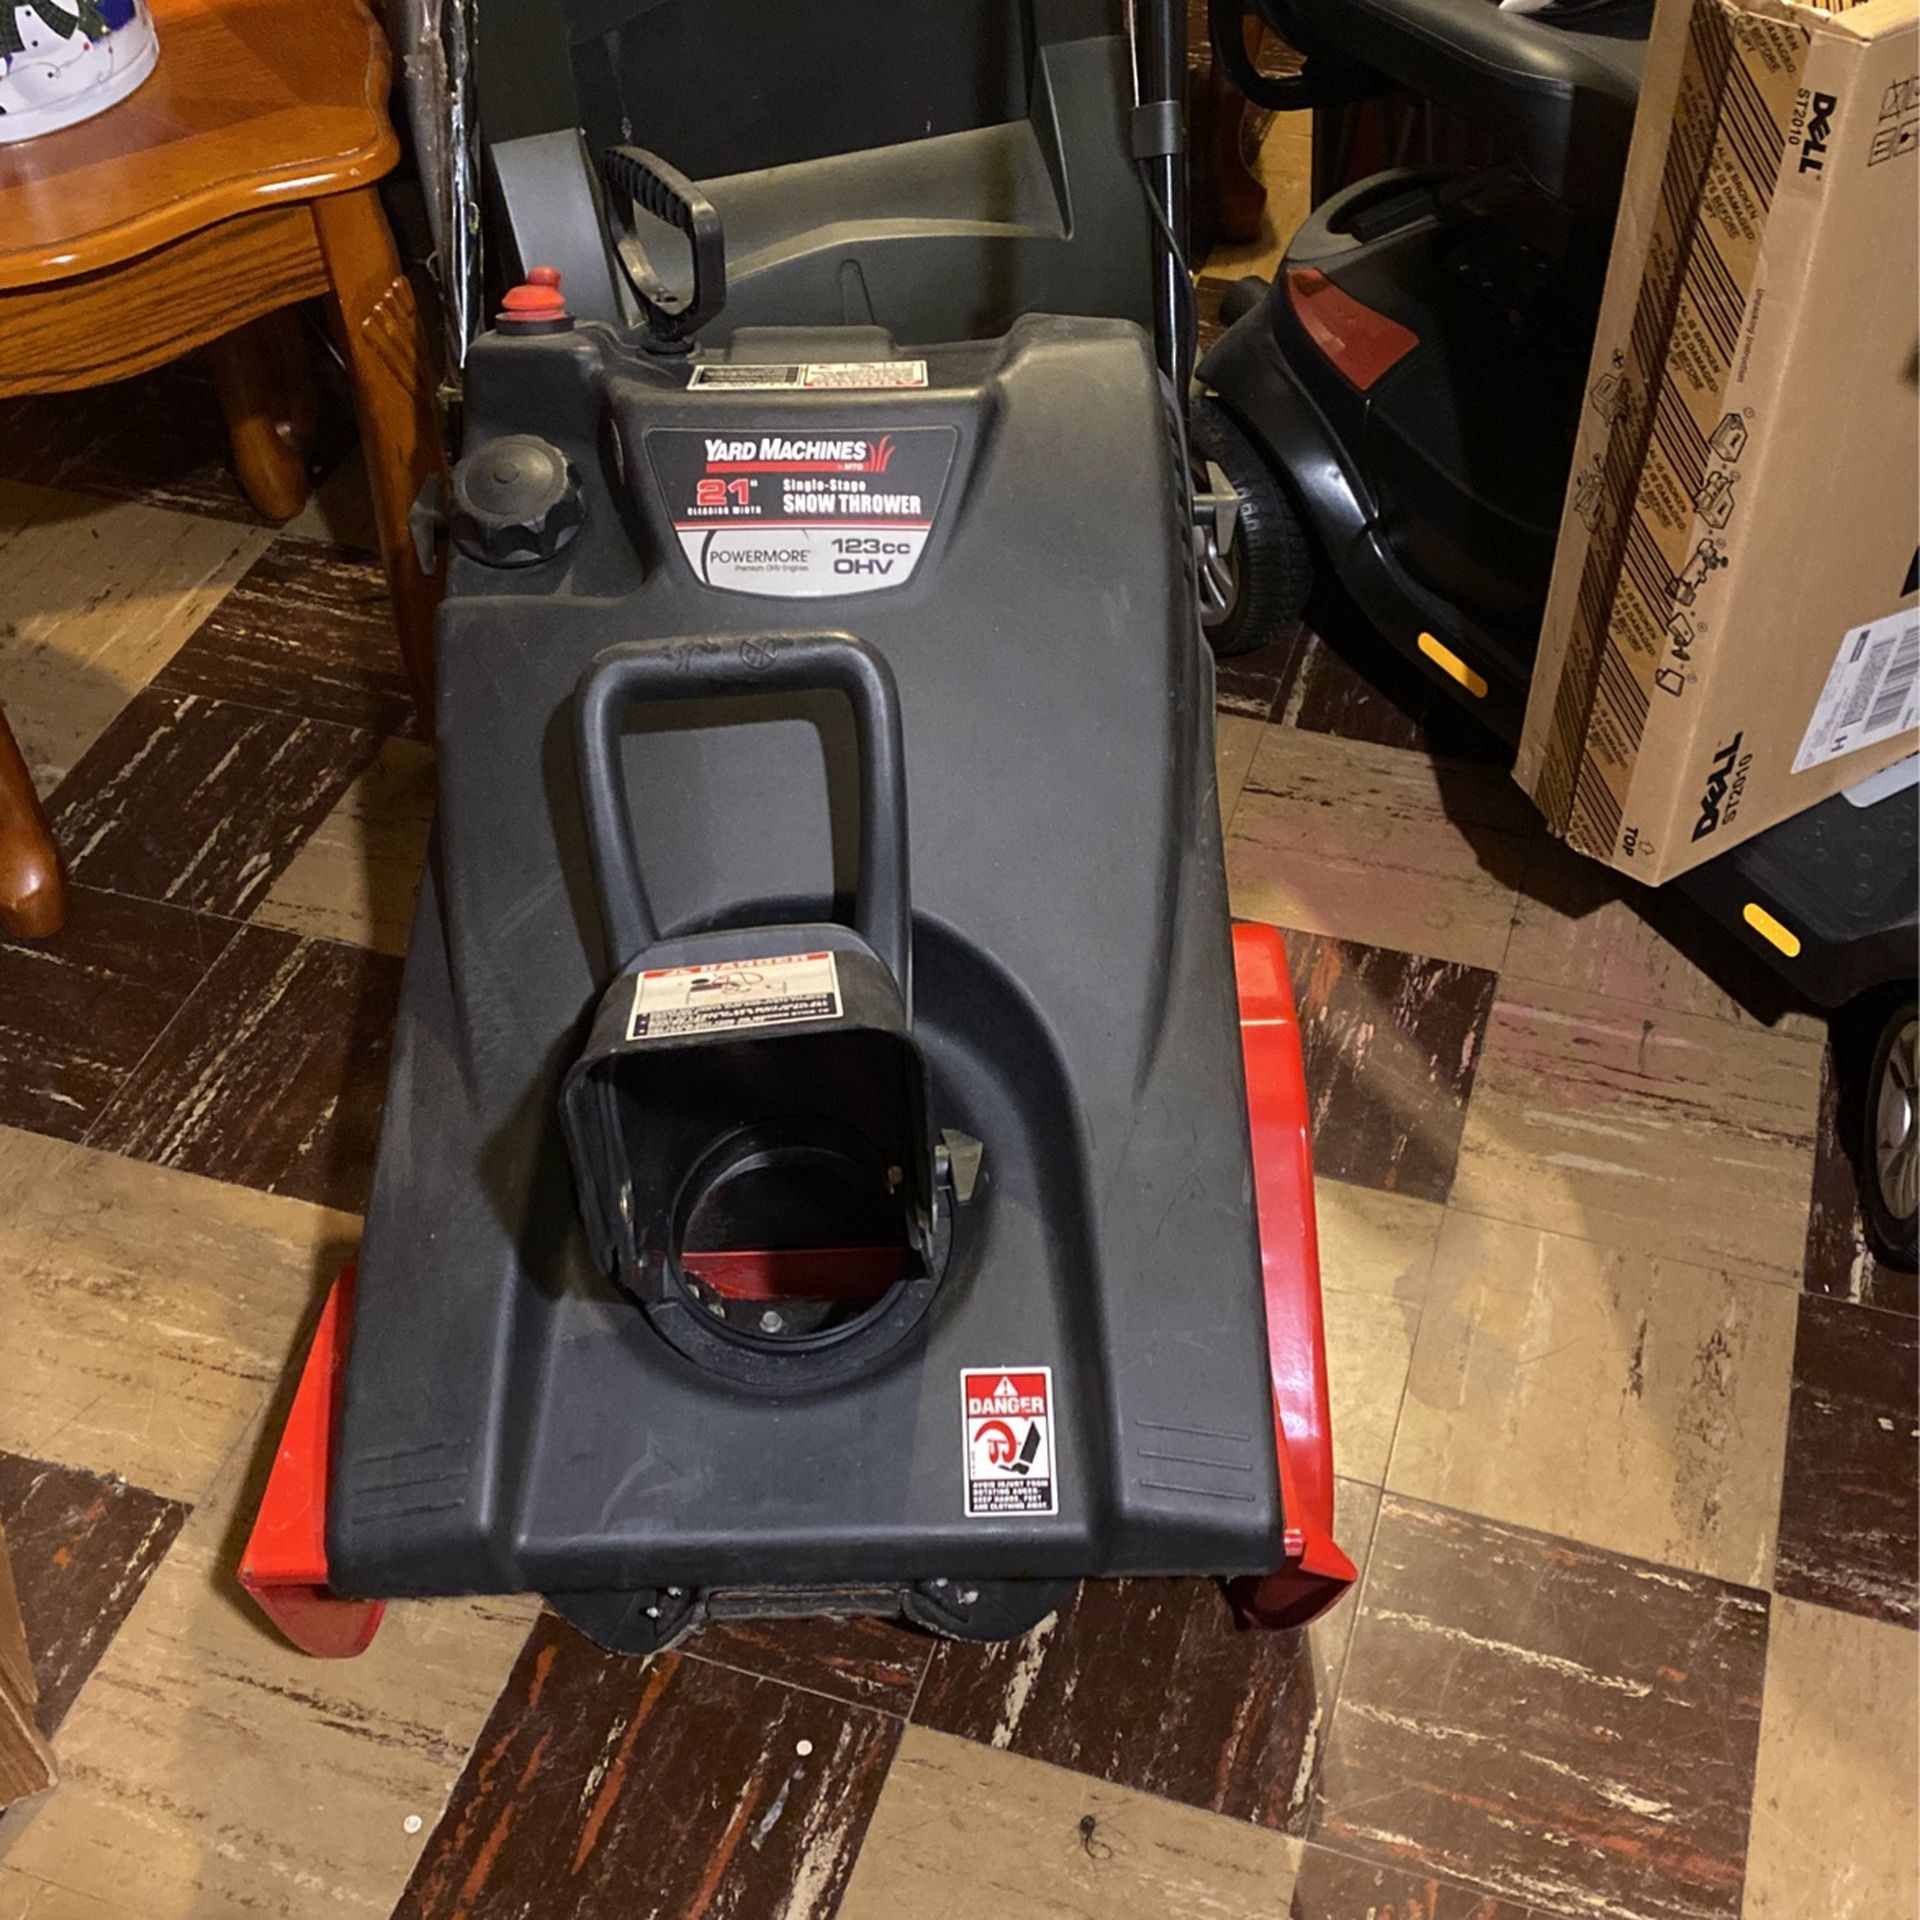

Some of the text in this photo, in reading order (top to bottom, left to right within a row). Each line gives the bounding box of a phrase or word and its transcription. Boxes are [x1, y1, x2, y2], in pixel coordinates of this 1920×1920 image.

[1789, 87, 1811, 146] ST2010
[1798, 91, 1838, 174] DELL
[704, 438, 867, 462] YARD MACHINES
[783, 478, 867, 493] Single-Stage
[783, 493, 921, 514] SNOW THROWER
[710, 549, 808, 563] POWERMORE
[831, 538, 911, 555] 123cc
[833, 558, 894, 575] OHV
[1691, 731, 1743, 843] DELL
[1722, 753, 1753, 825] ST2010
[1622, 826, 1638, 857] TOP
[969, 1397, 1045, 1415] DANGER
